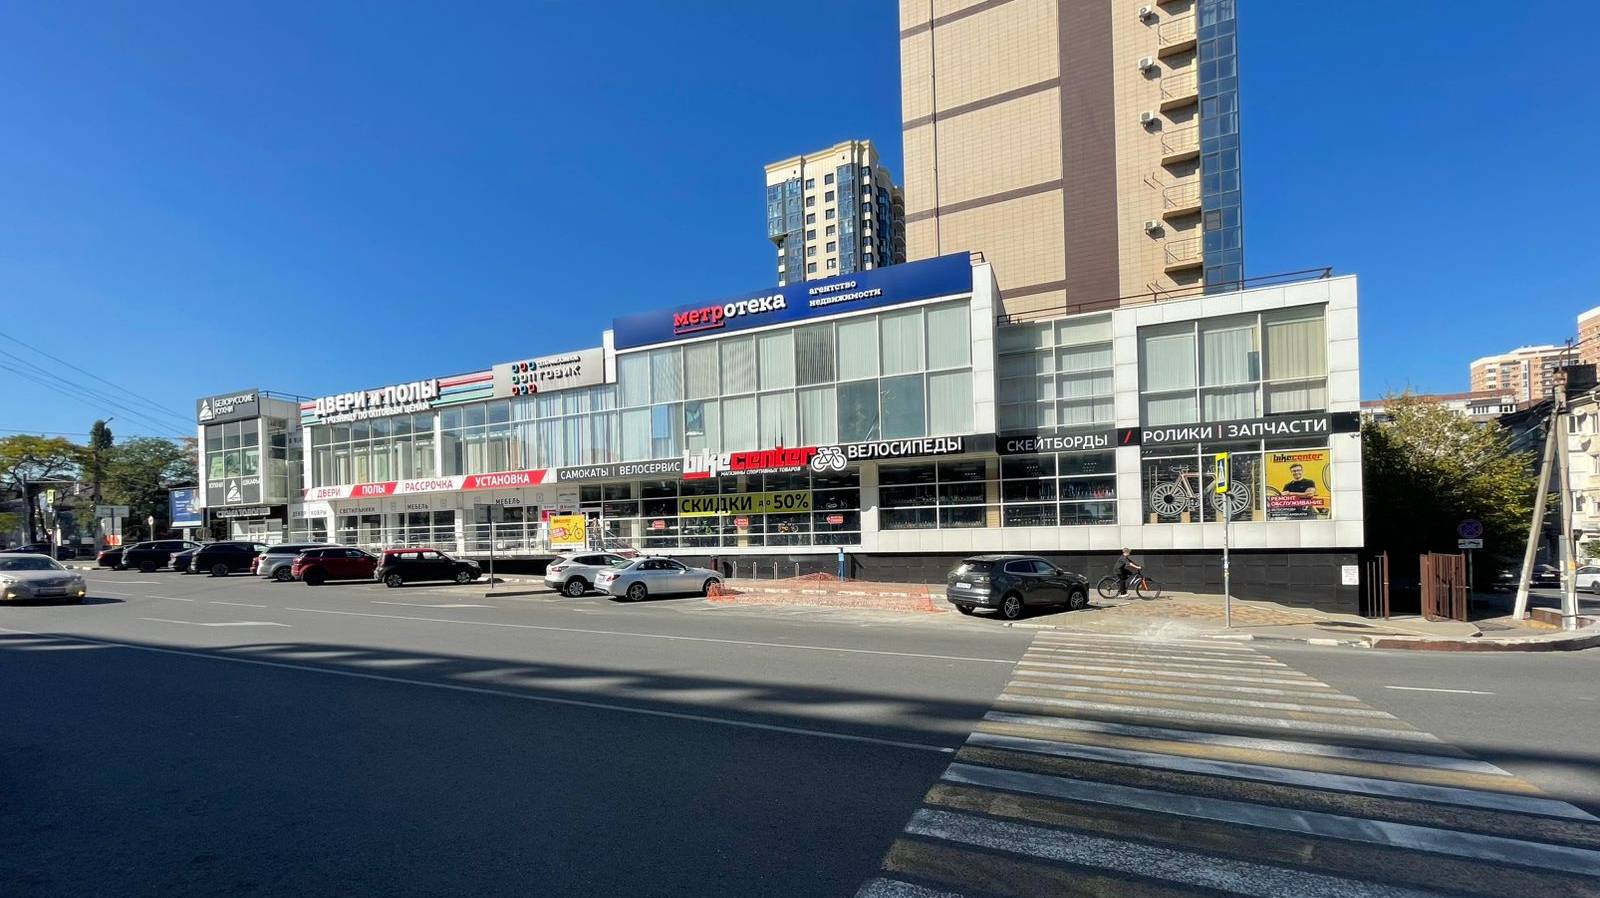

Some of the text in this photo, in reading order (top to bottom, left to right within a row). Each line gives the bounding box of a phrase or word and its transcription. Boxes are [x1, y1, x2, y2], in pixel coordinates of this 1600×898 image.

[809, 281, 857, 296] агентство
[809, 288, 882, 307] недвижимости
[673, 294, 787, 327] метротека
[314, 391, 368, 418] ДВЕРИ
[384, 379, 439, 405] ПОЛЫ
[1143, 417, 1328, 443] РОЛИКИ ЗАПЧАСТИ
[847, 437, 962, 459] ВЕЛОСИПЕДЫ
[1007, 434, 1109, 452] СКЕЙТБОРДЫ
[474, 473, 531, 487] УСТАНОВКА
[560, 461, 681, 480] САМОКАТЫ ВЕЛОСЕРВИС
[317, 487, 341, 499] ДВЕРИ
[361, 484, 386, 495] ПОЛЫ
[405, 480, 454, 491] РАССРОЧКА
[681, 495, 753, 514] СКИДКИ
[773, 493, 809, 510] 50%
